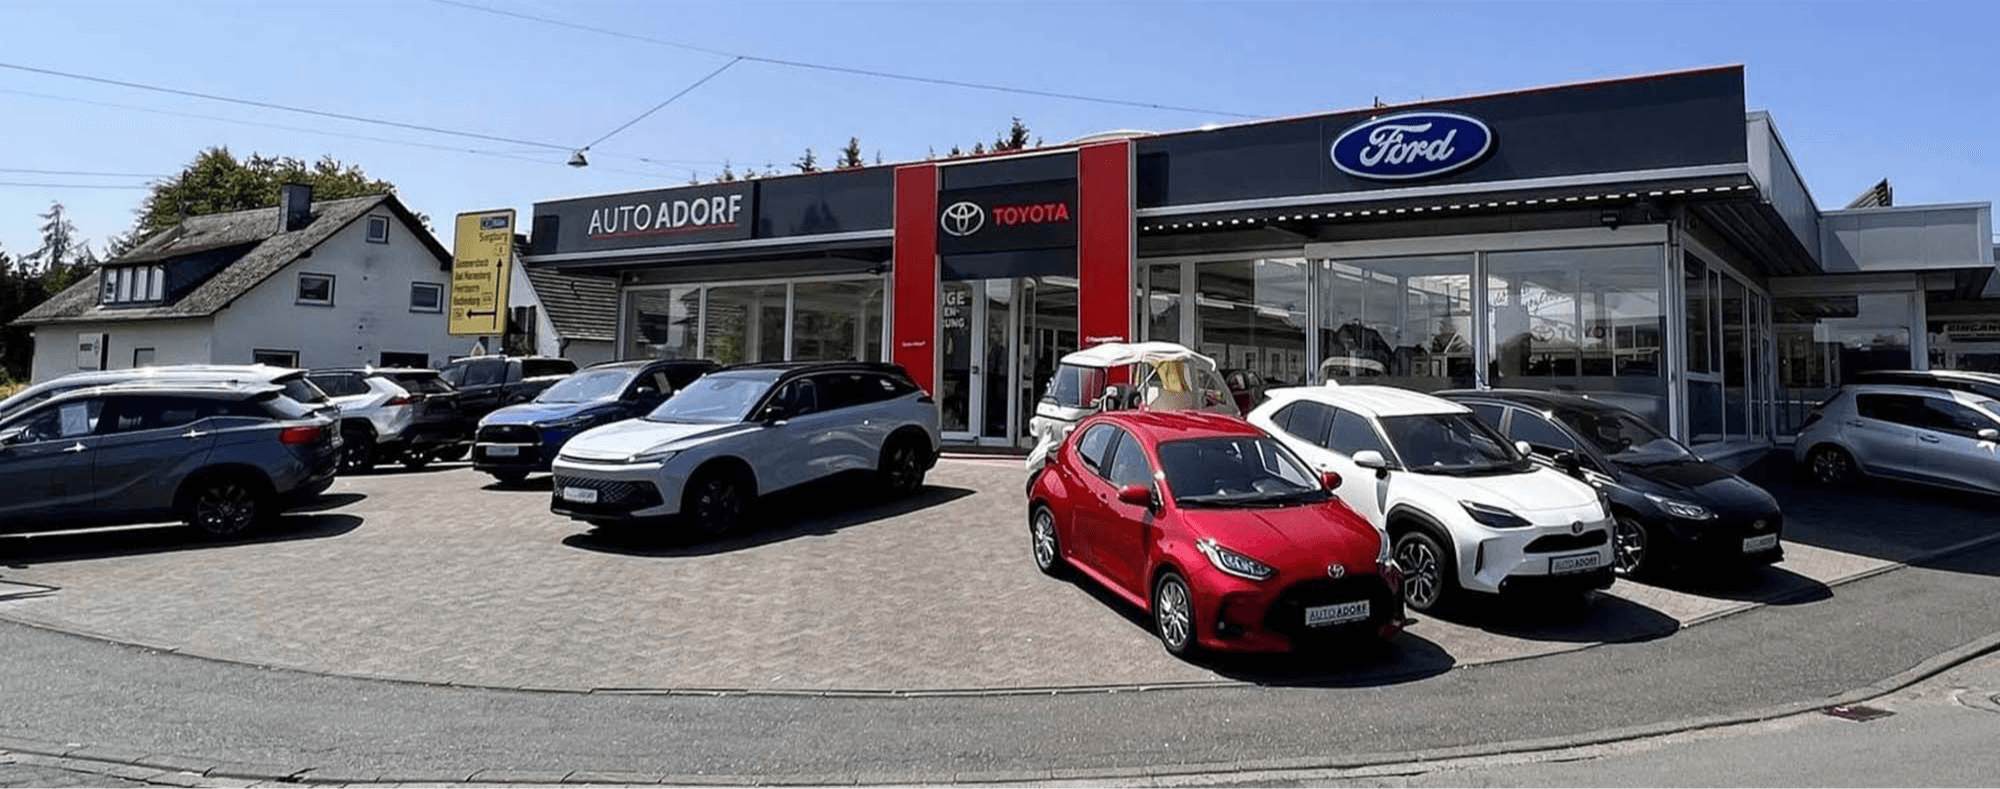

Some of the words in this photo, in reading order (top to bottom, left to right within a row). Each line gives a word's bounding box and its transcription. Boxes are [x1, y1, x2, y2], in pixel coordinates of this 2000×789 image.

[1360, 122, 1457, 166] Ford
[588, 204, 651, 235] AUTO
[654, 194, 742, 230] ADORF
[992, 203, 1070, 226] TOYOTA
[1310, 608, 1336, 620] AUTO
